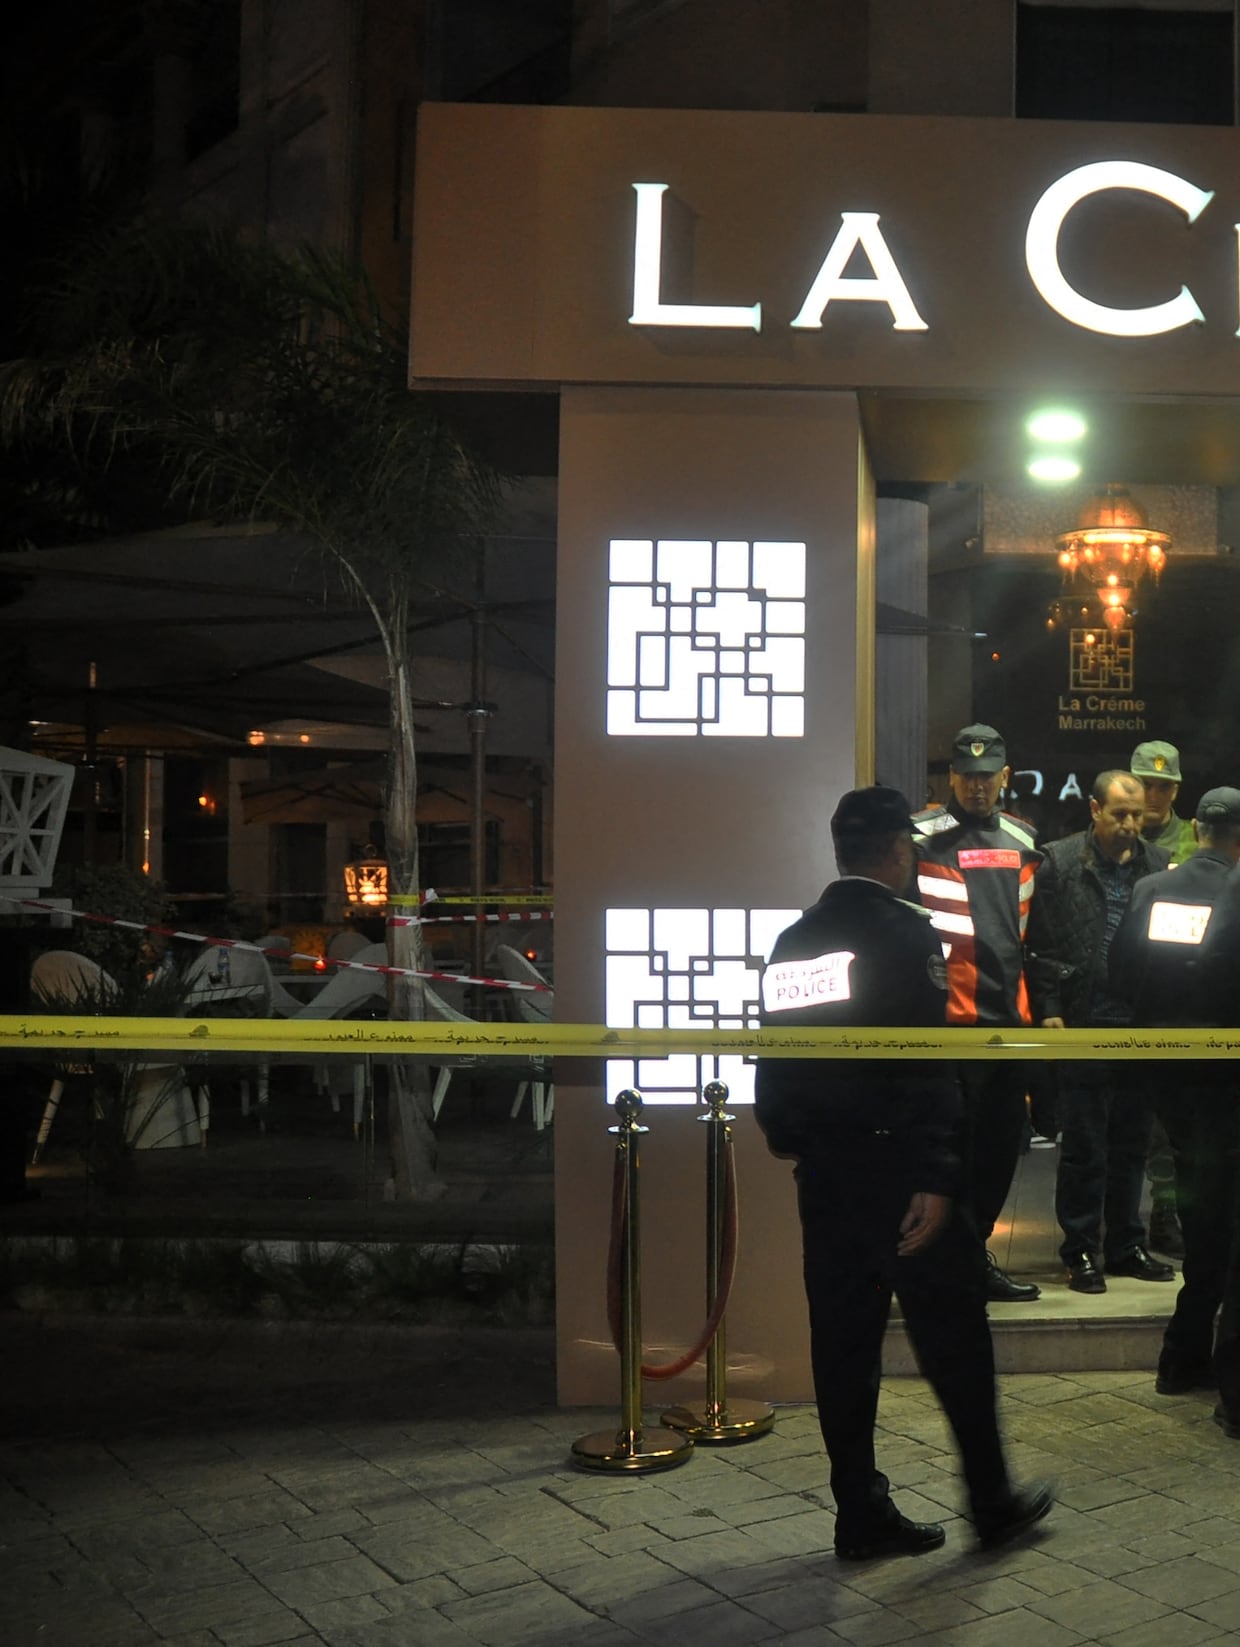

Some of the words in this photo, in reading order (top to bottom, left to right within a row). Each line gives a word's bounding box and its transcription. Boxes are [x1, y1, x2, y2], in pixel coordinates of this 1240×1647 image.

[1059, 695, 1081, 711] La
[1059, 715, 1146, 729] Marrakech
[776, 976, 838, 1001] POLICE
